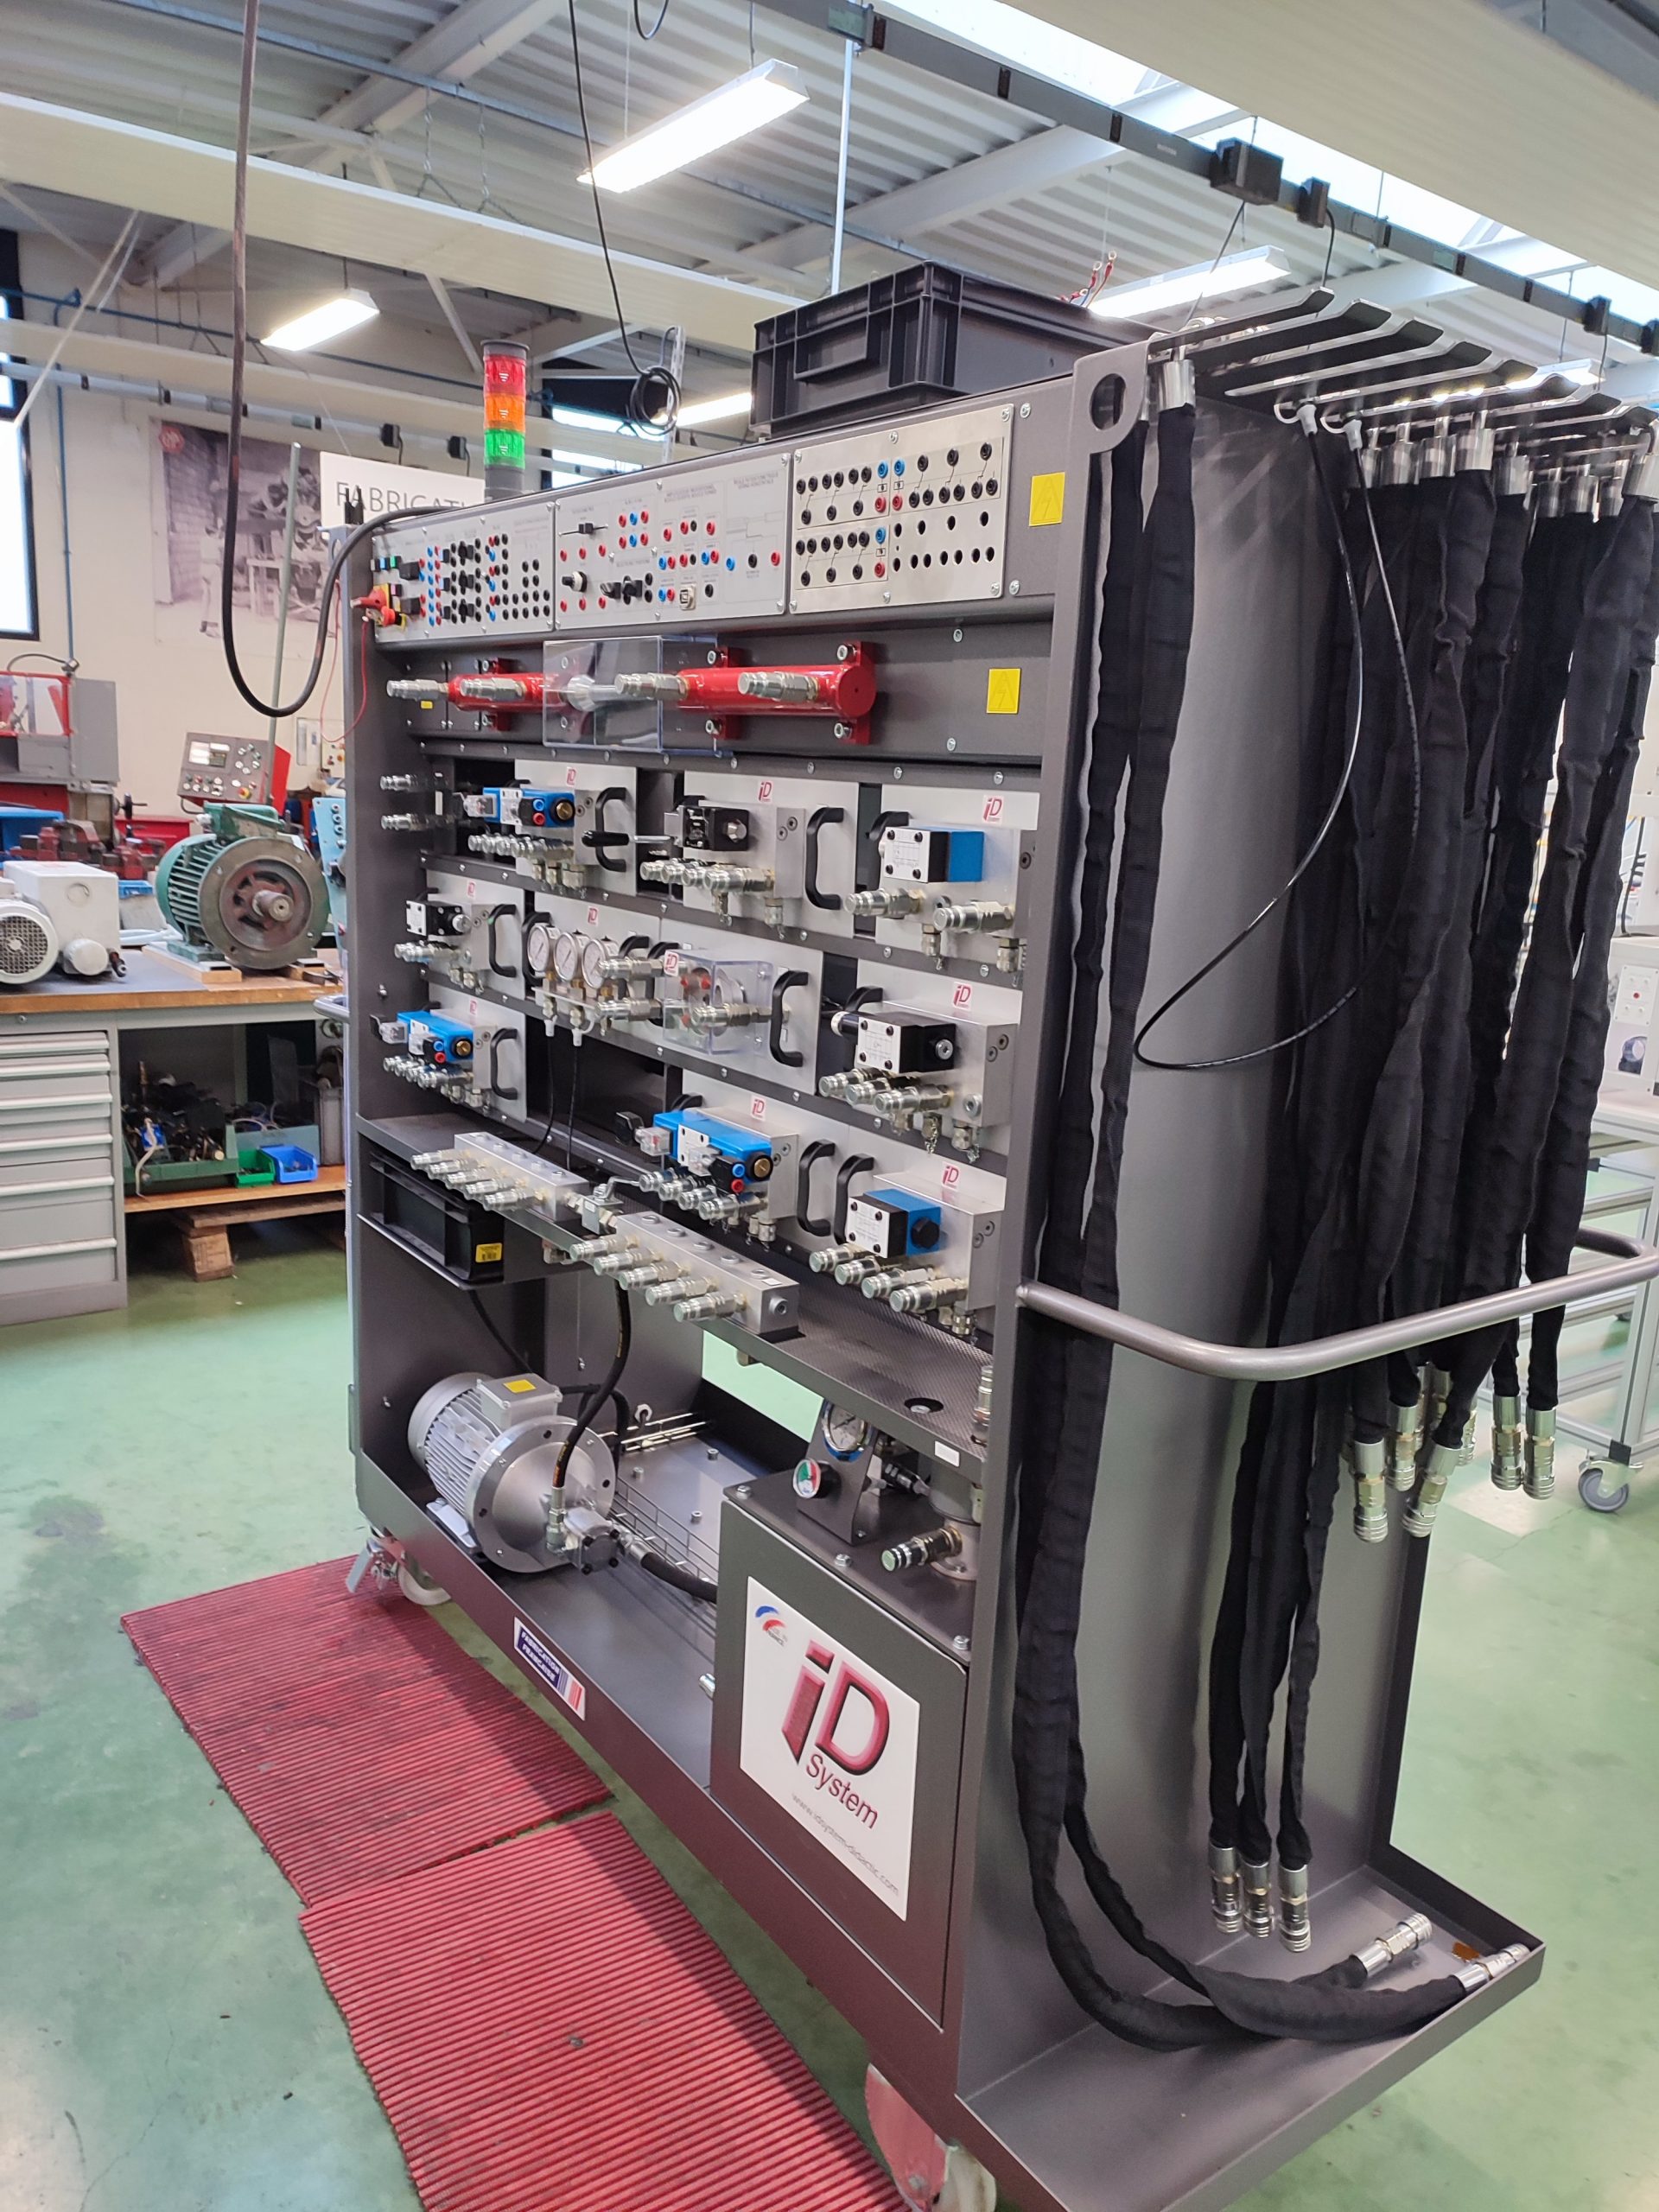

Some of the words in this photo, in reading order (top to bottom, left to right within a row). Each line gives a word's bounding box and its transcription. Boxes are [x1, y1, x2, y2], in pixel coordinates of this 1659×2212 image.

[759, 781, 772, 800] iD
[983, 798, 1002, 820] iD
[953, 985, 971, 1006] iD
[752, 1098, 765, 1115] iD
[942, 1166, 959, 1184] iD
[521, 1630, 560, 1675] FABRICATION
[781, 1639, 890, 1777] iD
[805, 1752, 878, 1830] System
